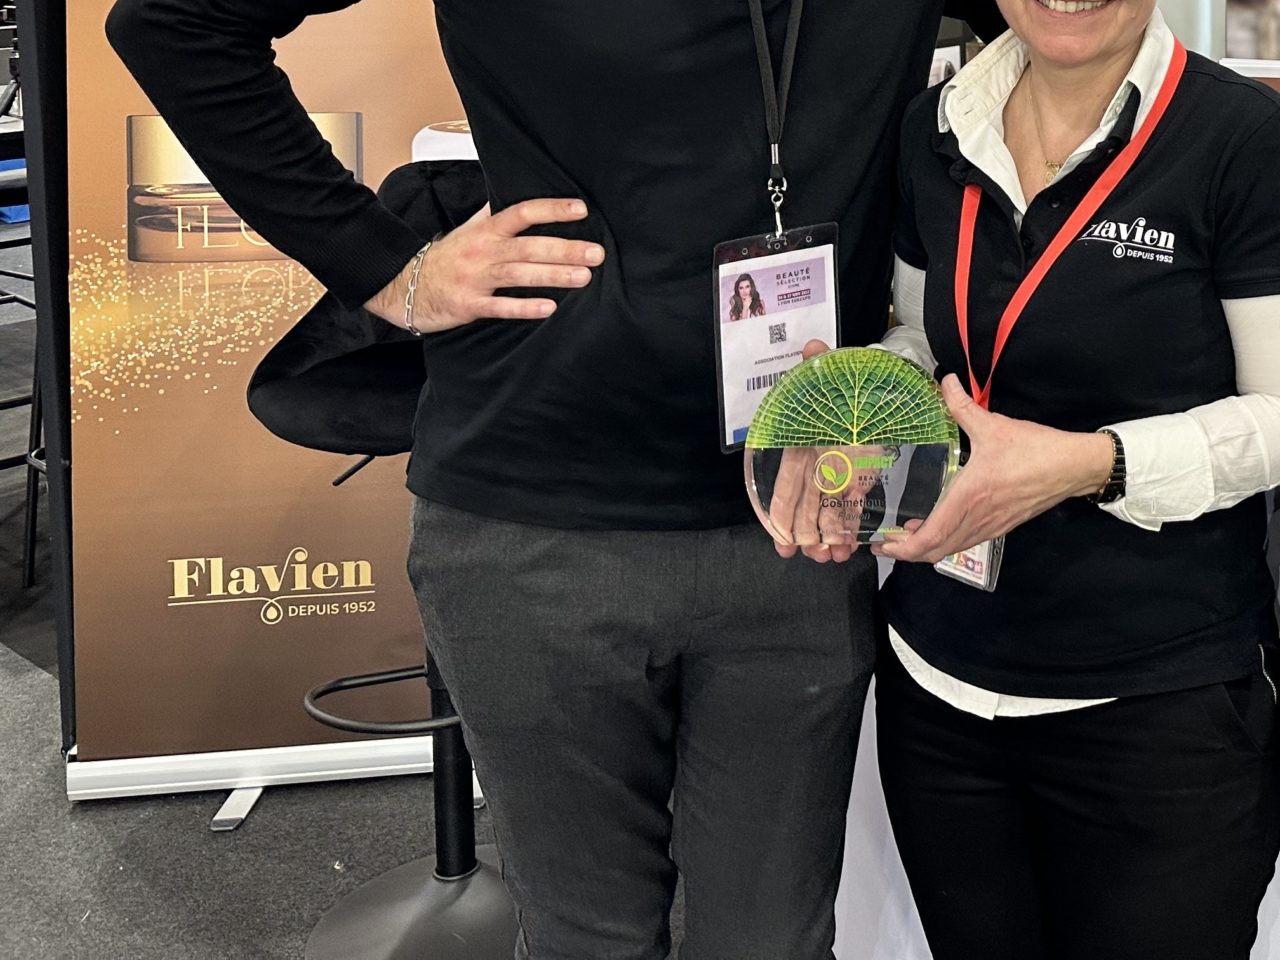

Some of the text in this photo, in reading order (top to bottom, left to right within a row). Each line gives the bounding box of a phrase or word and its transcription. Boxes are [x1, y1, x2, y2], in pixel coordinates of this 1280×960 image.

[1082, 217, 1175, 250] lavien
[1126, 248, 1174, 264] DEPUIS 1952
[776, 266, 810, 280] BEAUTÉ
[821, 496, 887, 509] Cosmétique
[168, 547, 375, 599] Flavien
[288, 601, 376, 617] DEPUIS 1952
